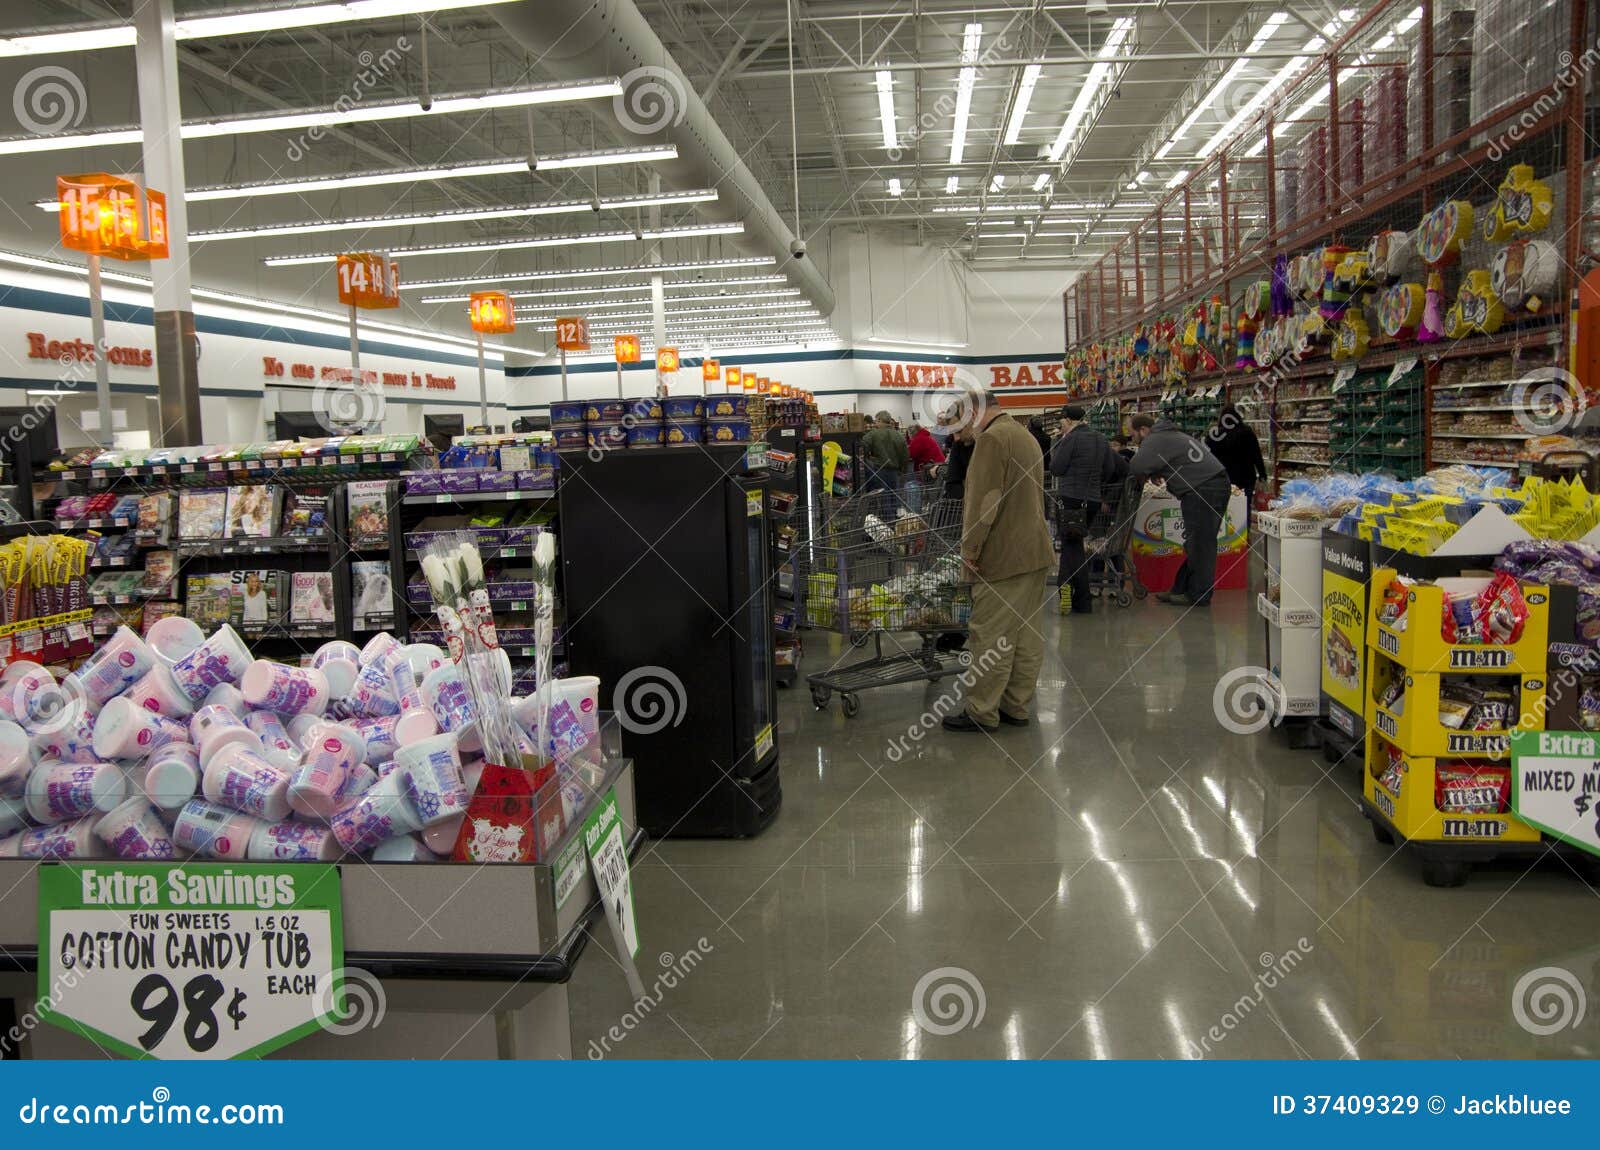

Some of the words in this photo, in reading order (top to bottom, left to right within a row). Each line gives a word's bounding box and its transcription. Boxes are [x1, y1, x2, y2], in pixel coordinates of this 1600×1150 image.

[63, 188, 100, 232] 15
[339, 263, 368, 294] 14
[559, 323, 577, 343] 12
[27, 332, 153, 367] Restroms
[263, 356, 284, 377] No
[879, 363, 957, 388] BAKERY
[1325, 547, 1340, 564] Value
[1341, 552, 1364, 572] Movies
[1324, 591, 1363, 627] TREASURE
[1331, 606, 1352, 628] HUNT!
[1539, 733, 1596, 756] Extra
[1524, 769, 1575, 792] MIXED
[82, 869, 159, 905] Extra
[167, 869, 295, 908] Savings
[129, 913, 159, 930] FUN
[165, 912, 231, 930] SWEETS
[255, 916, 275, 931] 1.5
[281, 916, 300, 931] OZ
[60, 931, 155, 969] COTTON
[165, 931, 251, 970] CANDY
[261, 931, 312, 969] TUB
[267, 974, 317, 996] EACH
